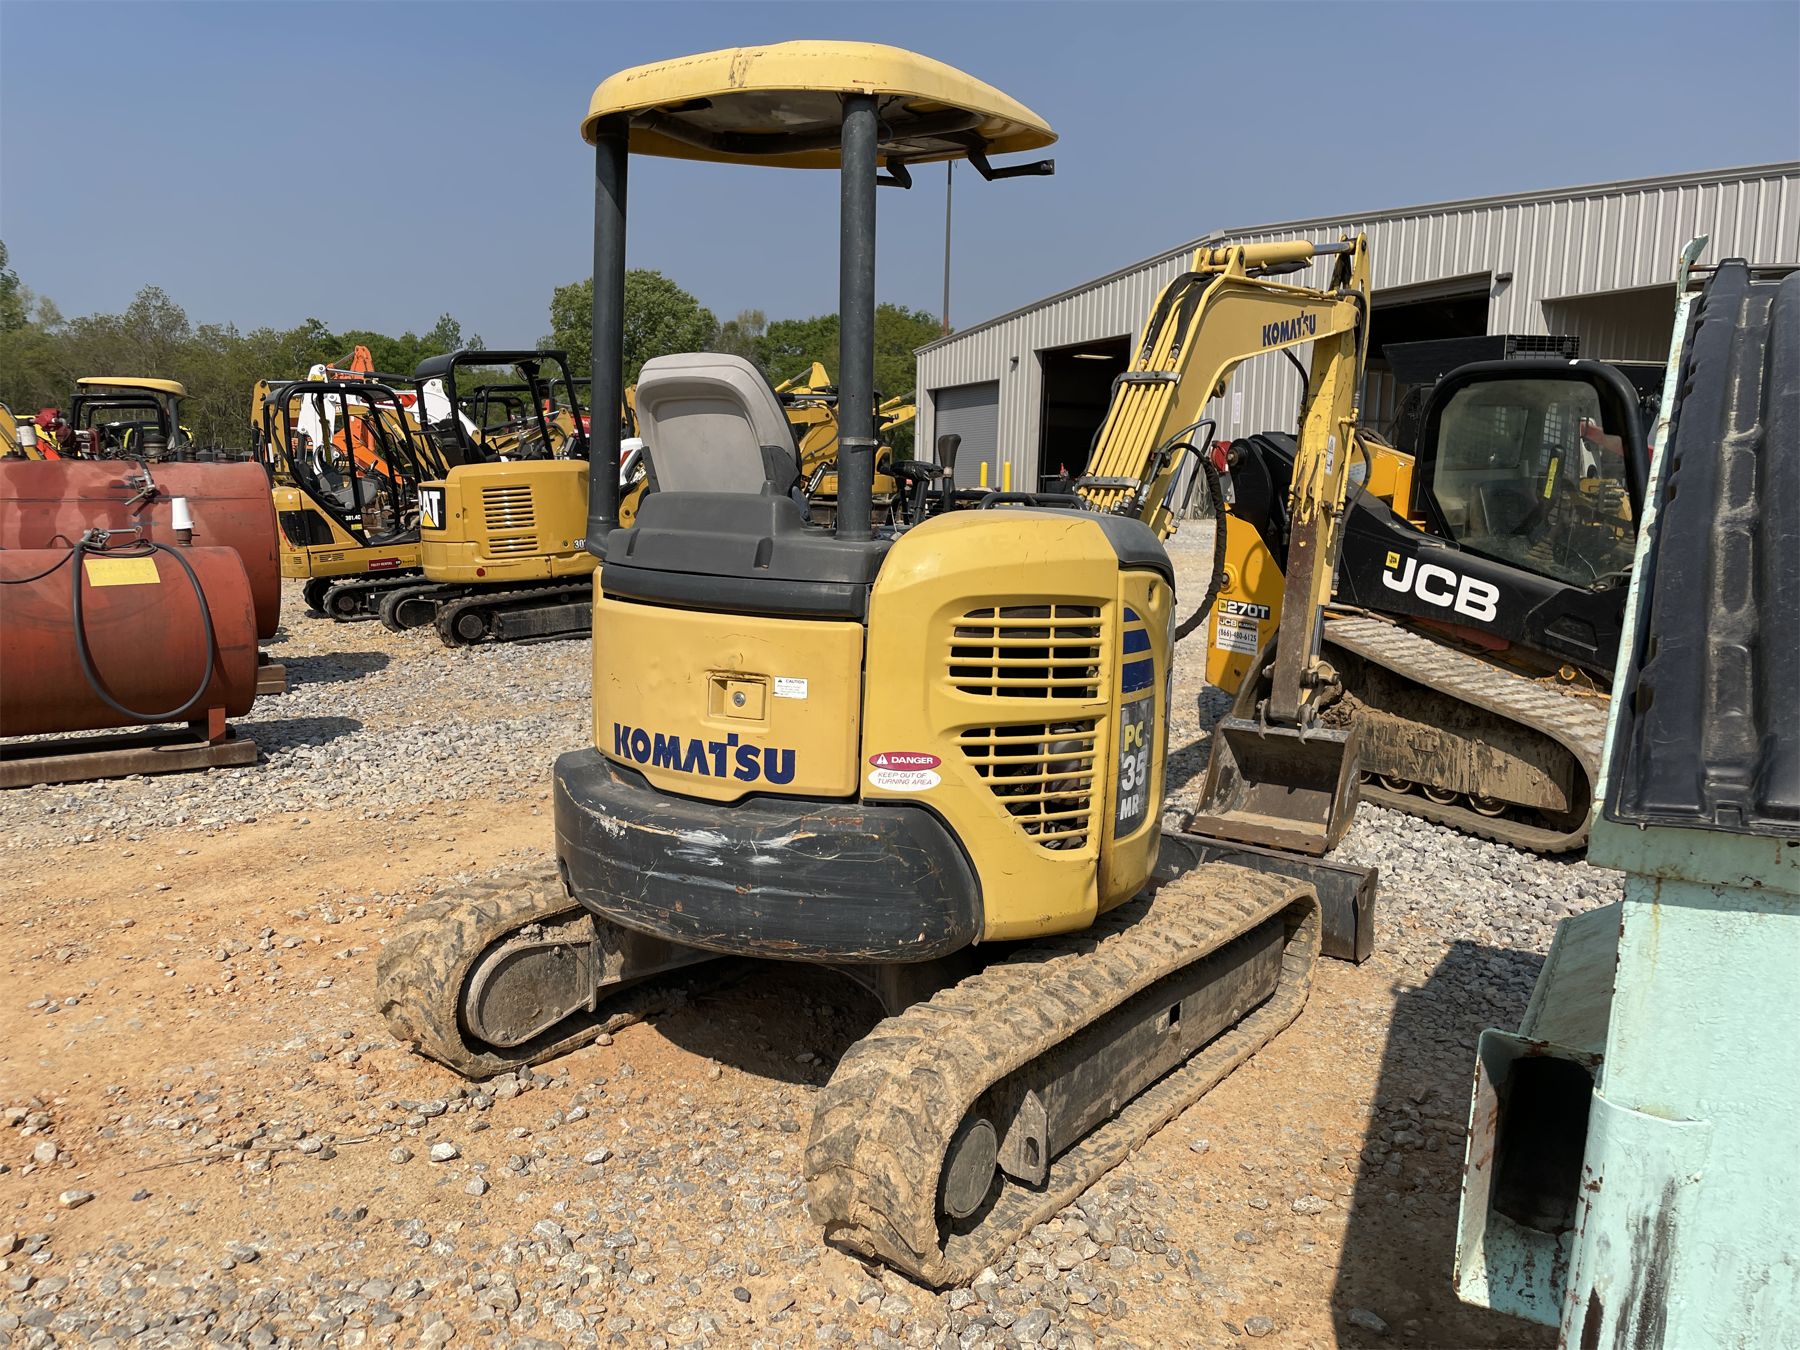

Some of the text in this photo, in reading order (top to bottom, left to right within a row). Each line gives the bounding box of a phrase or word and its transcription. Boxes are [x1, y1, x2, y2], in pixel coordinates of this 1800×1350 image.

[1263, 310, 1316, 347] KOMATSU
[574, 539, 586, 549] 30
[1382, 557, 1500, 622] JCB
[1227, 600, 1269, 618] 270T
[1123, 720, 1144, 752] PC
[614, 722, 796, 785] KOMATSU
[891, 756, 933, 764] DANGER
[1121, 751, 1146, 791] 35
[1120, 795, 1139, 820] MR
